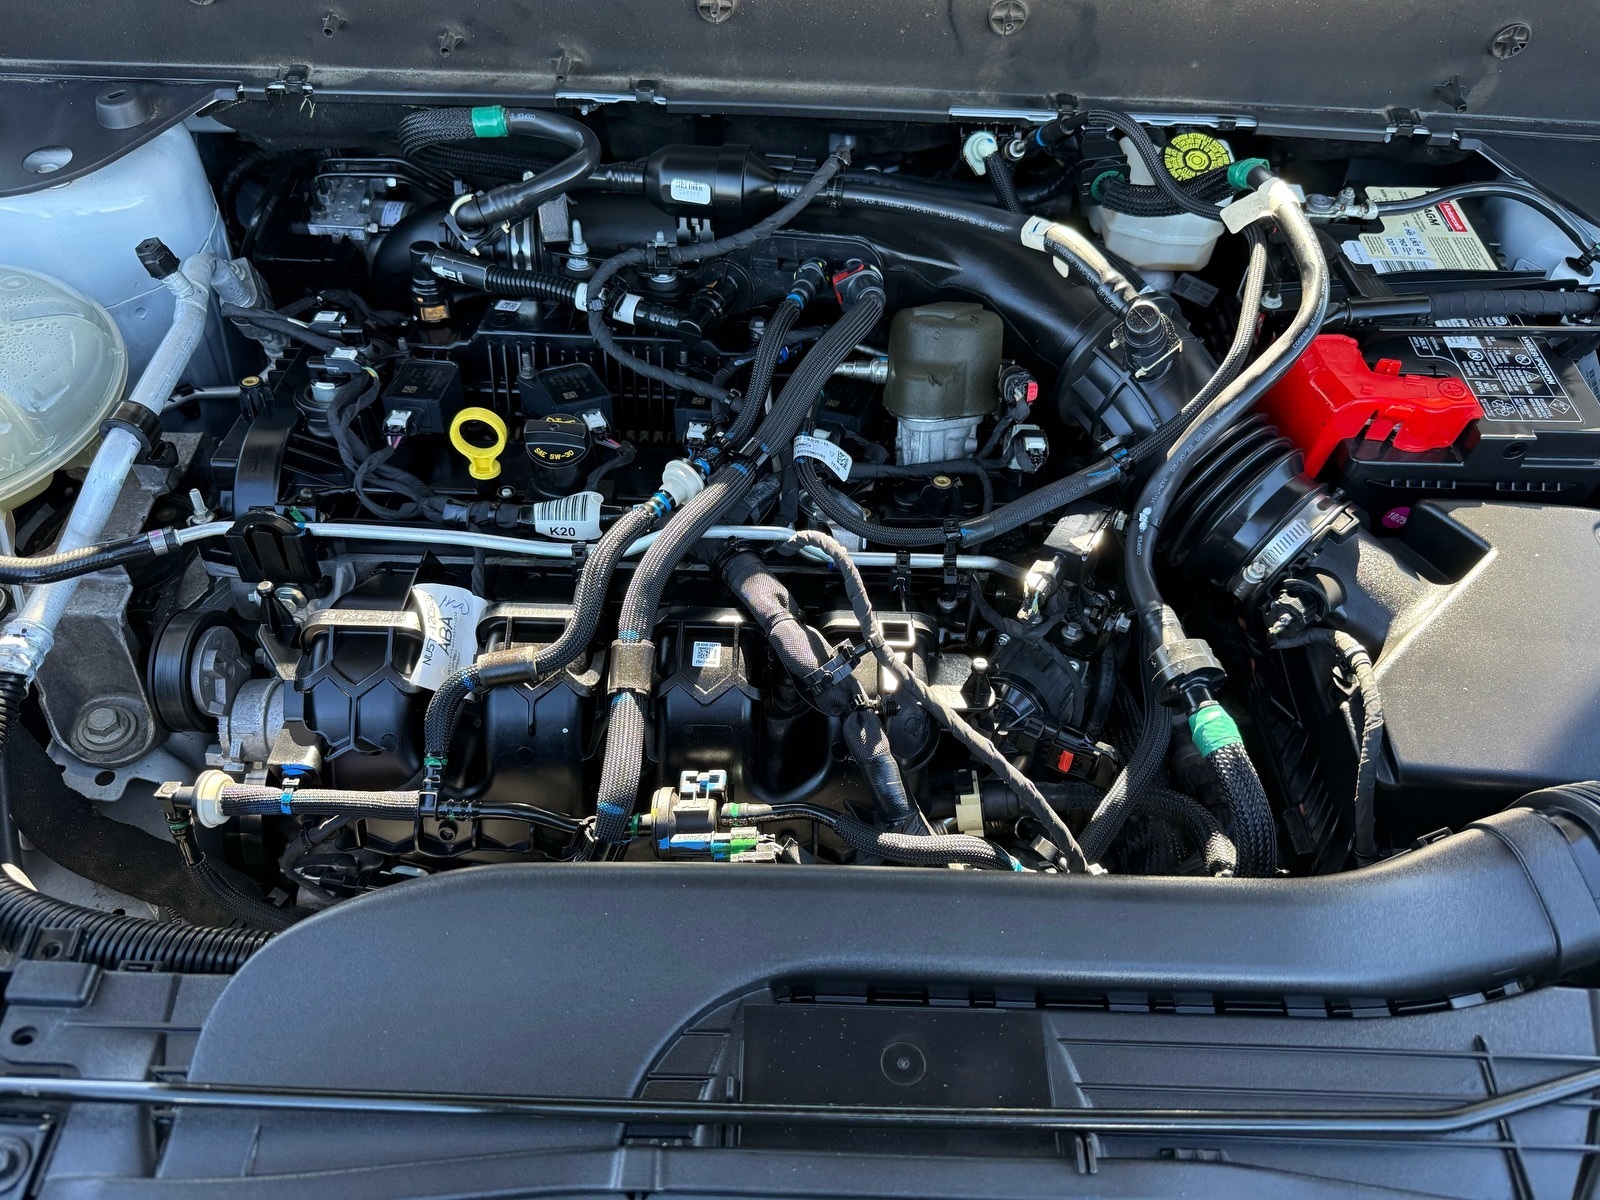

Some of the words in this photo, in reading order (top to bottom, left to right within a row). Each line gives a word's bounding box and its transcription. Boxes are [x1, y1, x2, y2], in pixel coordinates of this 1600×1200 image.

[855, 197, 876, 206] COOPER
[1424, 208, 1441, 226] AGM
[1444, 203, 1463, 231] Motorcraft
[1292, 328, 1310, 349] COOPER
[1216, 398, 1239, 420] FoMoCo
[534, 447, 547, 458] SAE
[549, 449, 575, 460] 5W-30
[549, 527, 576, 537] K20
[438, 616, 453, 656] ABA
